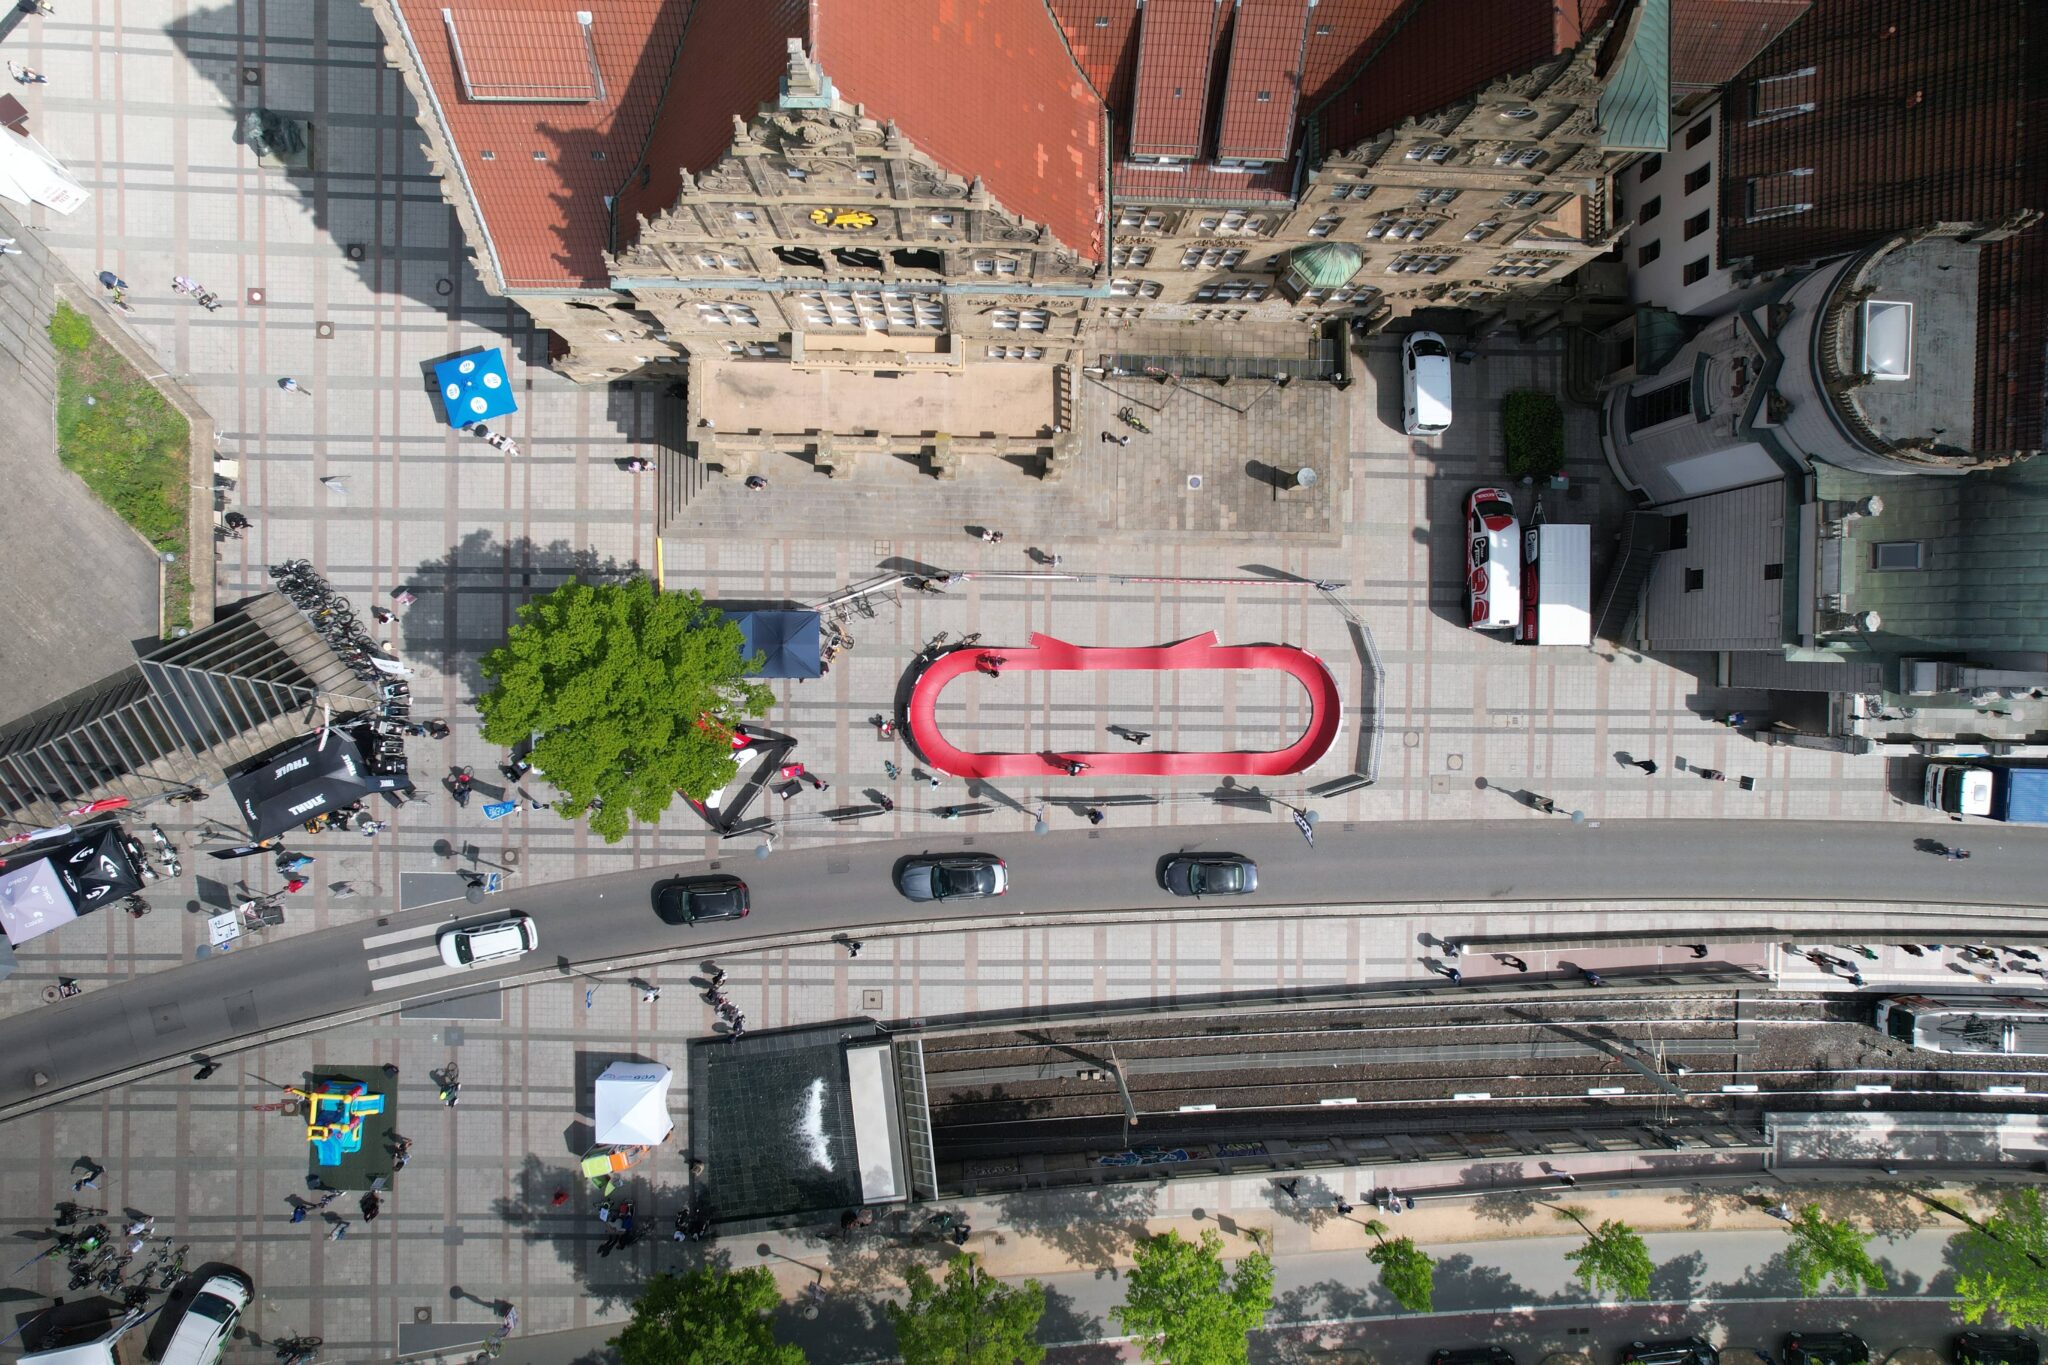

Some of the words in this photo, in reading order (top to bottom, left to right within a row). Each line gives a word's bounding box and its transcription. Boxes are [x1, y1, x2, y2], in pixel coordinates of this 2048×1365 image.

[276, 756, 310, 780] THULE
[341, 754, 357, 777] THULE
[288, 794, 326, 816] THULE
